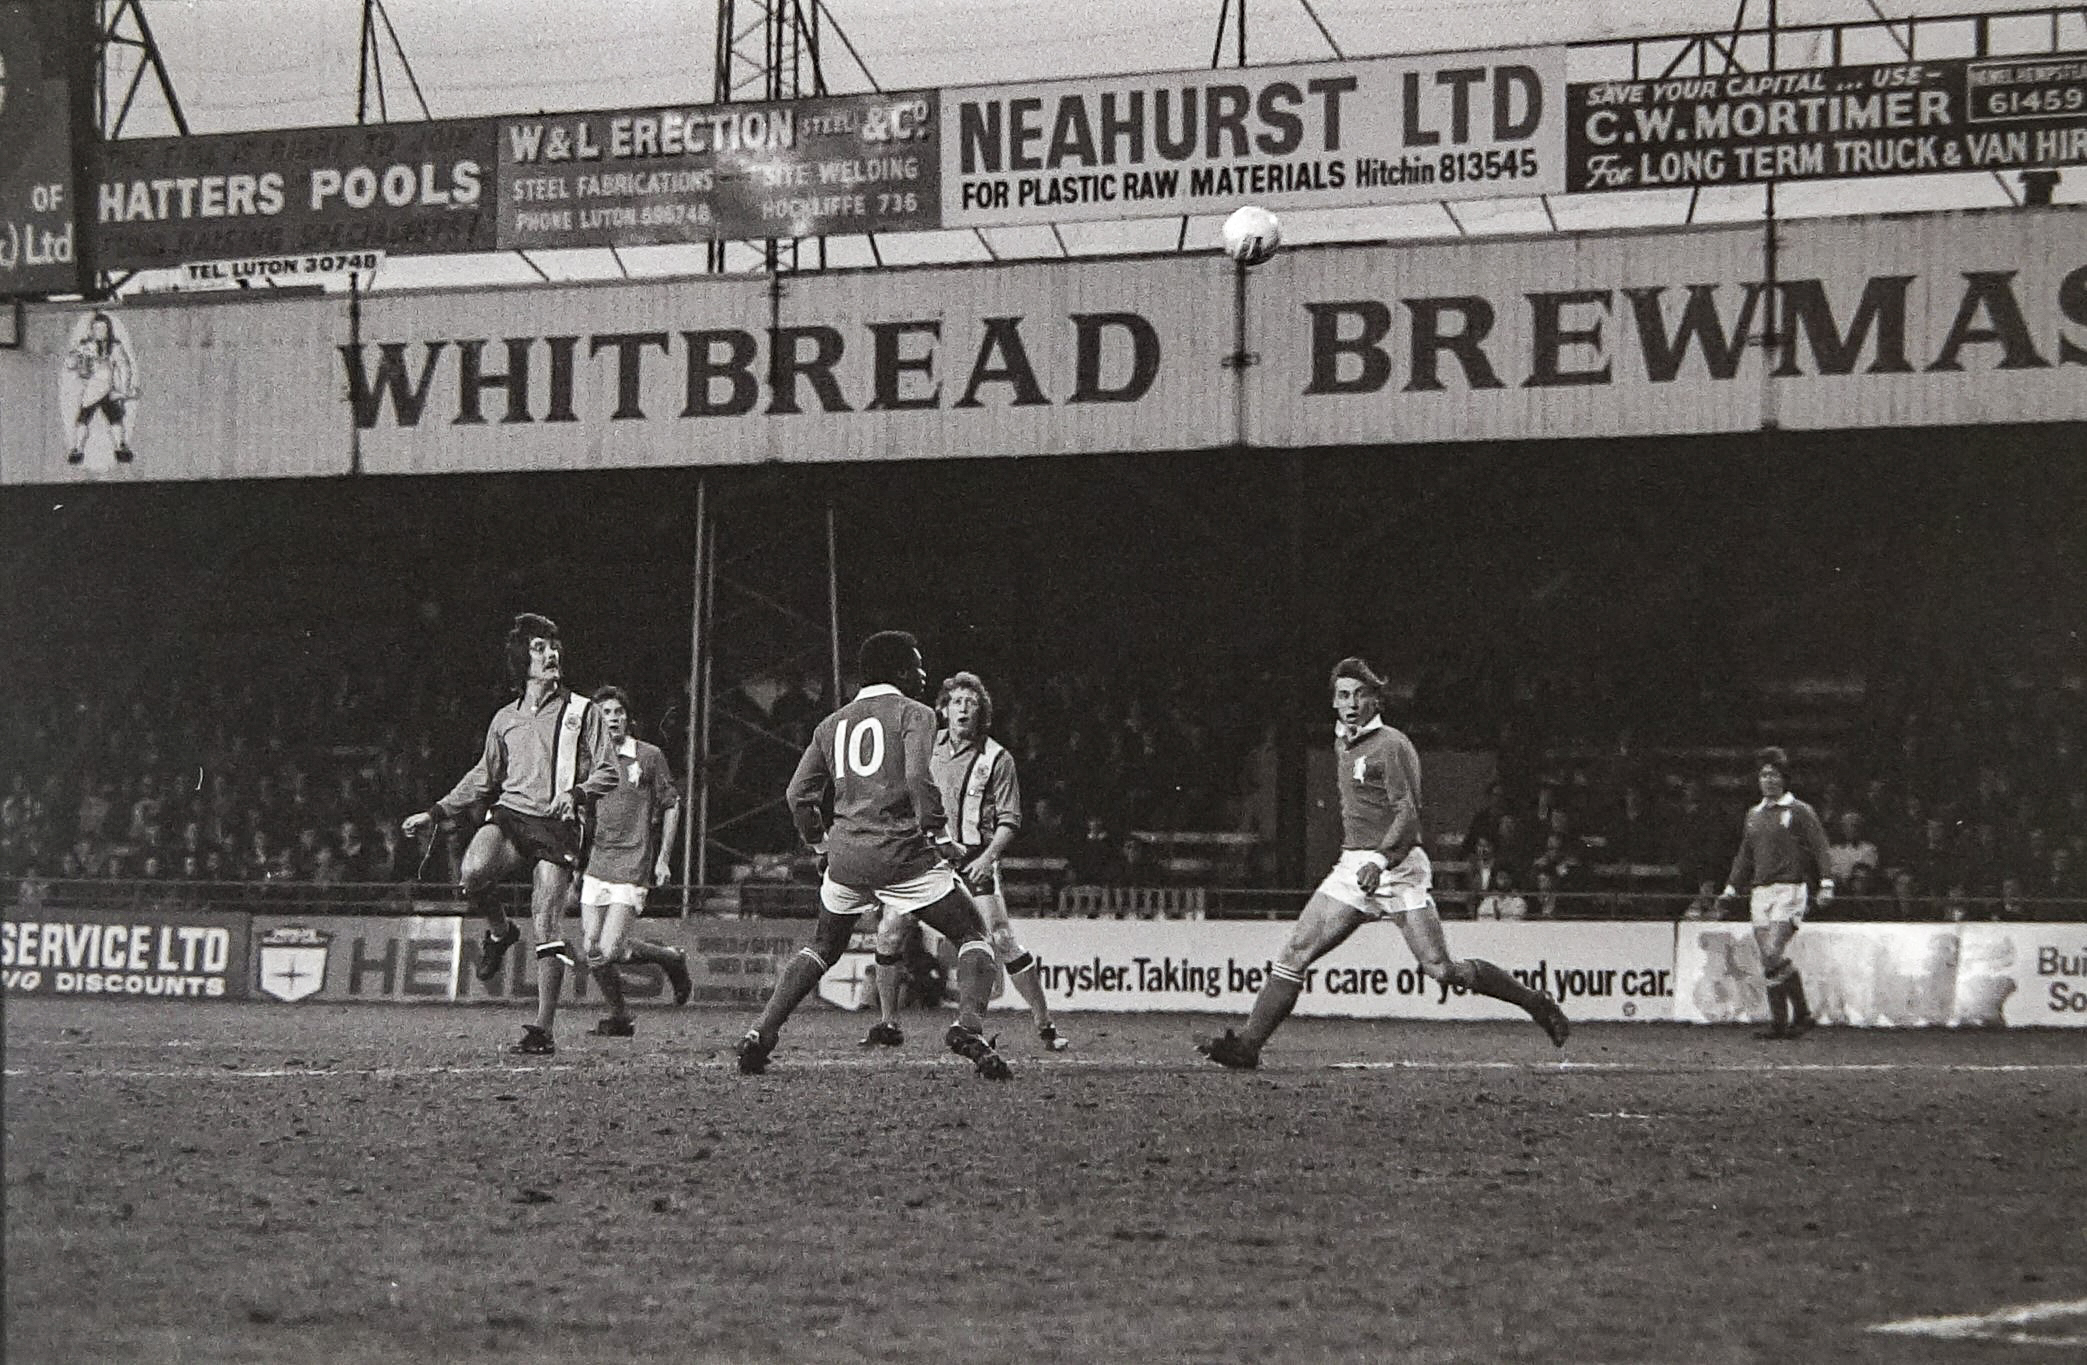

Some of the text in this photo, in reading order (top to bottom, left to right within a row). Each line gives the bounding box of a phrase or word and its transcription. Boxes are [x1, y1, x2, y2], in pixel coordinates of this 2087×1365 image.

[1585, 83, 1646, 106] SAVE
[1653, 80, 1717, 102] YOUR
[1726, 72, 1826, 97] CAPITAL
[611, 108, 793, 157] ERECTION
[959, 65, 1544, 174] NEAHURST LTD
[513, 177, 570, 200] STEEL
[577, 169, 714, 198] FABRICATIONS
[819, 156, 919, 183] WELDING
[961, 147, 1538, 210] FOR PLASTIC RAW MATERIALS Hitchin 813545
[1585, 153, 1634, 188] For
[1640, 149, 1725, 183] LONG
[1734, 141, 1824, 178] TERM
[1833, 135, 1939, 173] TRUCK
[1942, 139, 1961, 167] &
[1967, 130, 2027, 164] VAN
[32, 184, 64, 213] OF
[100, 160, 481, 222] HATTERS POOLS
[25, 221, 73, 264] Ltd
[231, 260, 299, 277] LUTON
[338, 312, 1162, 429] WHITBREAD
[834, 716, 885, 779] 10
[1, 921, 230, 972] SERVICE LTD
[56, 972, 226, 997] DISCOUNTS
[1132, 956, 1221, 998] Taking
[1325, 966, 1388, 996] care
[1554, 968, 1616, 1003] your
[1622, 968, 1674, 997] car.
